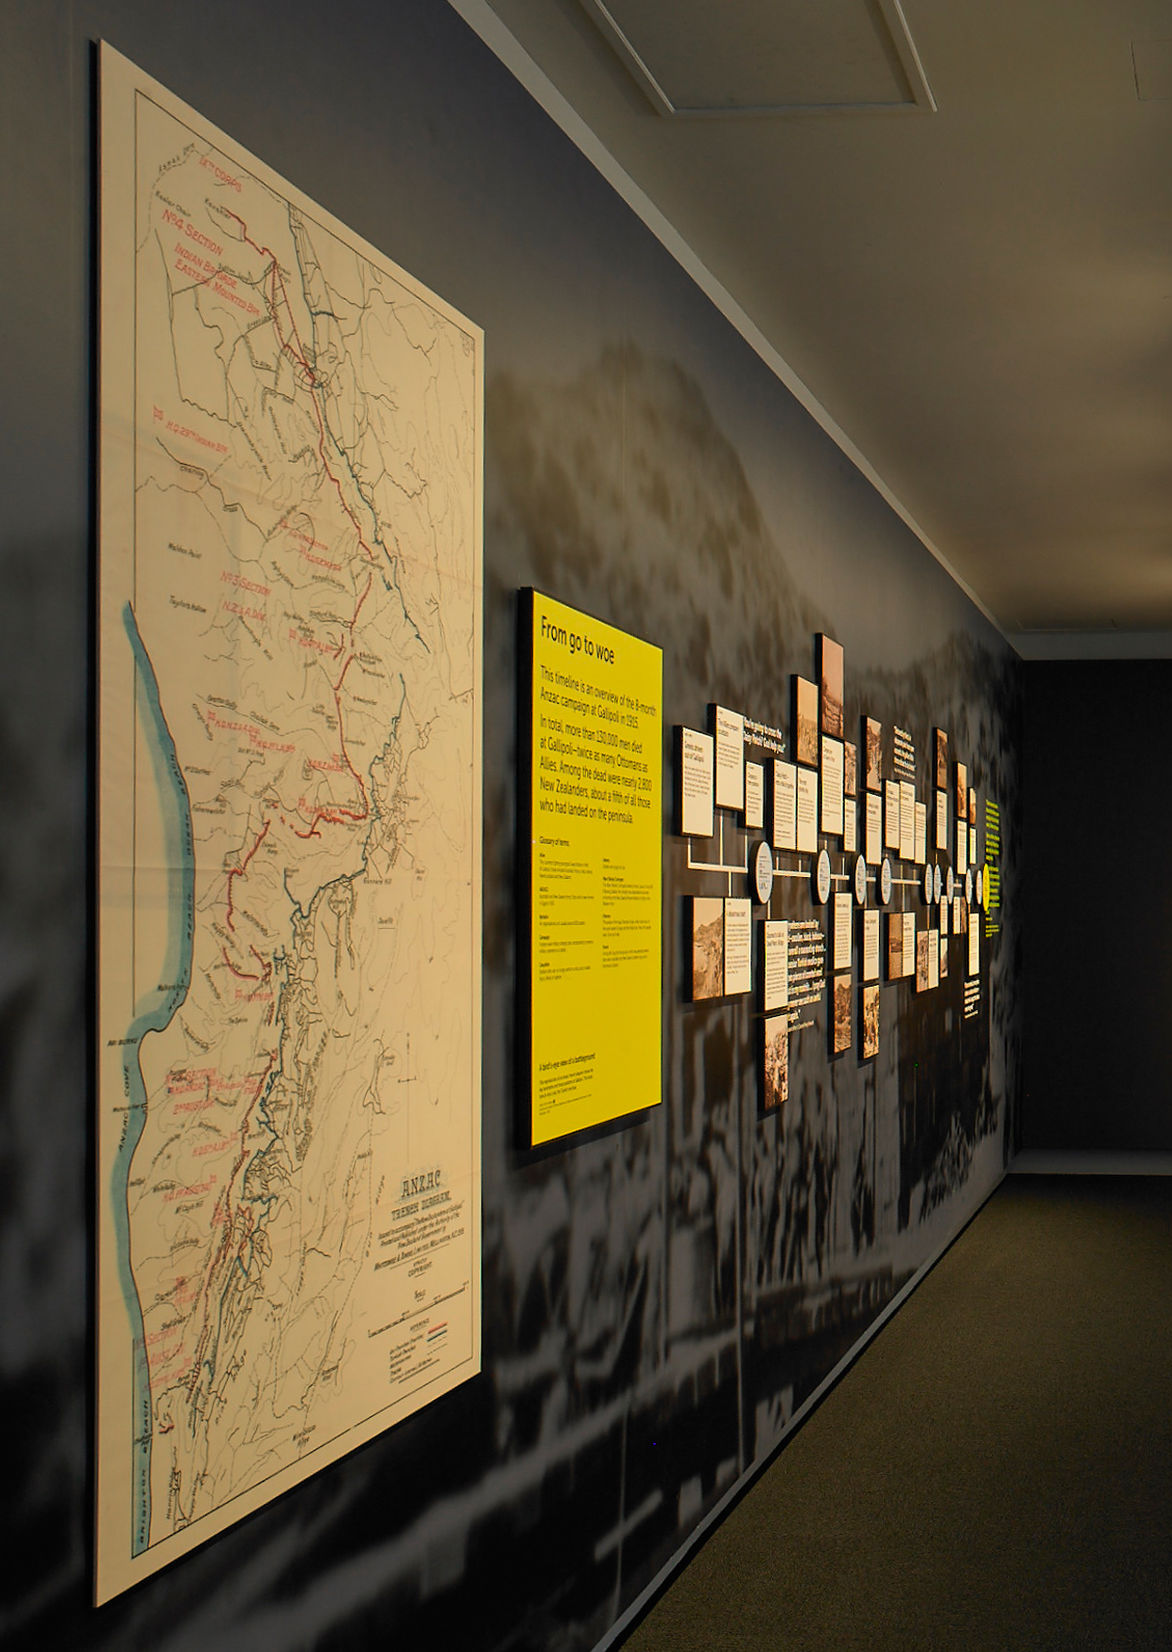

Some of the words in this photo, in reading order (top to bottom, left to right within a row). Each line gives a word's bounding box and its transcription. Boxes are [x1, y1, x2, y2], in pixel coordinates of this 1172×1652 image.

[174, 242, 202, 266] INDIAN
[185, 222, 223, 256] SECTION
[541, 615, 567, 645] From
[569, 633, 582, 654] go
[584, 636, 594, 656] to
[596, 643, 615, 664] woe
[540, 665, 554, 683] This
[555, 672, 579, 692] timeline
[580, 680, 585, 693] is
[586, 684, 594, 695] an
[595, 687, 618, 704] overview
[620, 694, 625, 706] of
[626, 696, 634, 708] the
[540, 687, 560, 705] Anzac
[561, 696, 590, 716] campaign
[591, 704, 597, 716] at
[597, 705, 619, 723] Gallipoli
[540, 713, 547, 728] In
[548, 719, 563, 733] total,
[565, 724, 581, 737] more
[582, 727, 595, 741] than
[619, 738, 631, 751] men
[631, 740, 643, 754] died
[540, 737, 547, 749] at
[594, 751, 600, 761] as
[601, 752, 615, 768] many
[617, 754, 642, 772] Ottomans
[642, 763, 648, 773] as
[540, 776, 554, 792] New
[556, 778, 589, 799] Zealanders,
[590, 786, 606, 800] about
[608, 792, 611, 802] a
[612, 790, 622, 803] fifth
[624, 793, 630, 804] of
[638, 796, 651, 809] those
[559, 760, 581, 780] Among
[582, 765, 592, 780] the
[593, 769, 606, 782] dead
[607, 774, 620, 785] were
[621, 775, 637, 792] nearly
[540, 798, 554, 812] who
[555, 800, 567, 814] had
[568, 802, 588, 817] landed
[589, 808, 596, 818] on
[598, 808, 607, 820] the
[540, 836, 555, 847] Glossary
[555, 837, 560, 846] of
[118, 1112, 129, 1152] ANZAC
[401, 1169, 441, 1198] ANZAC
